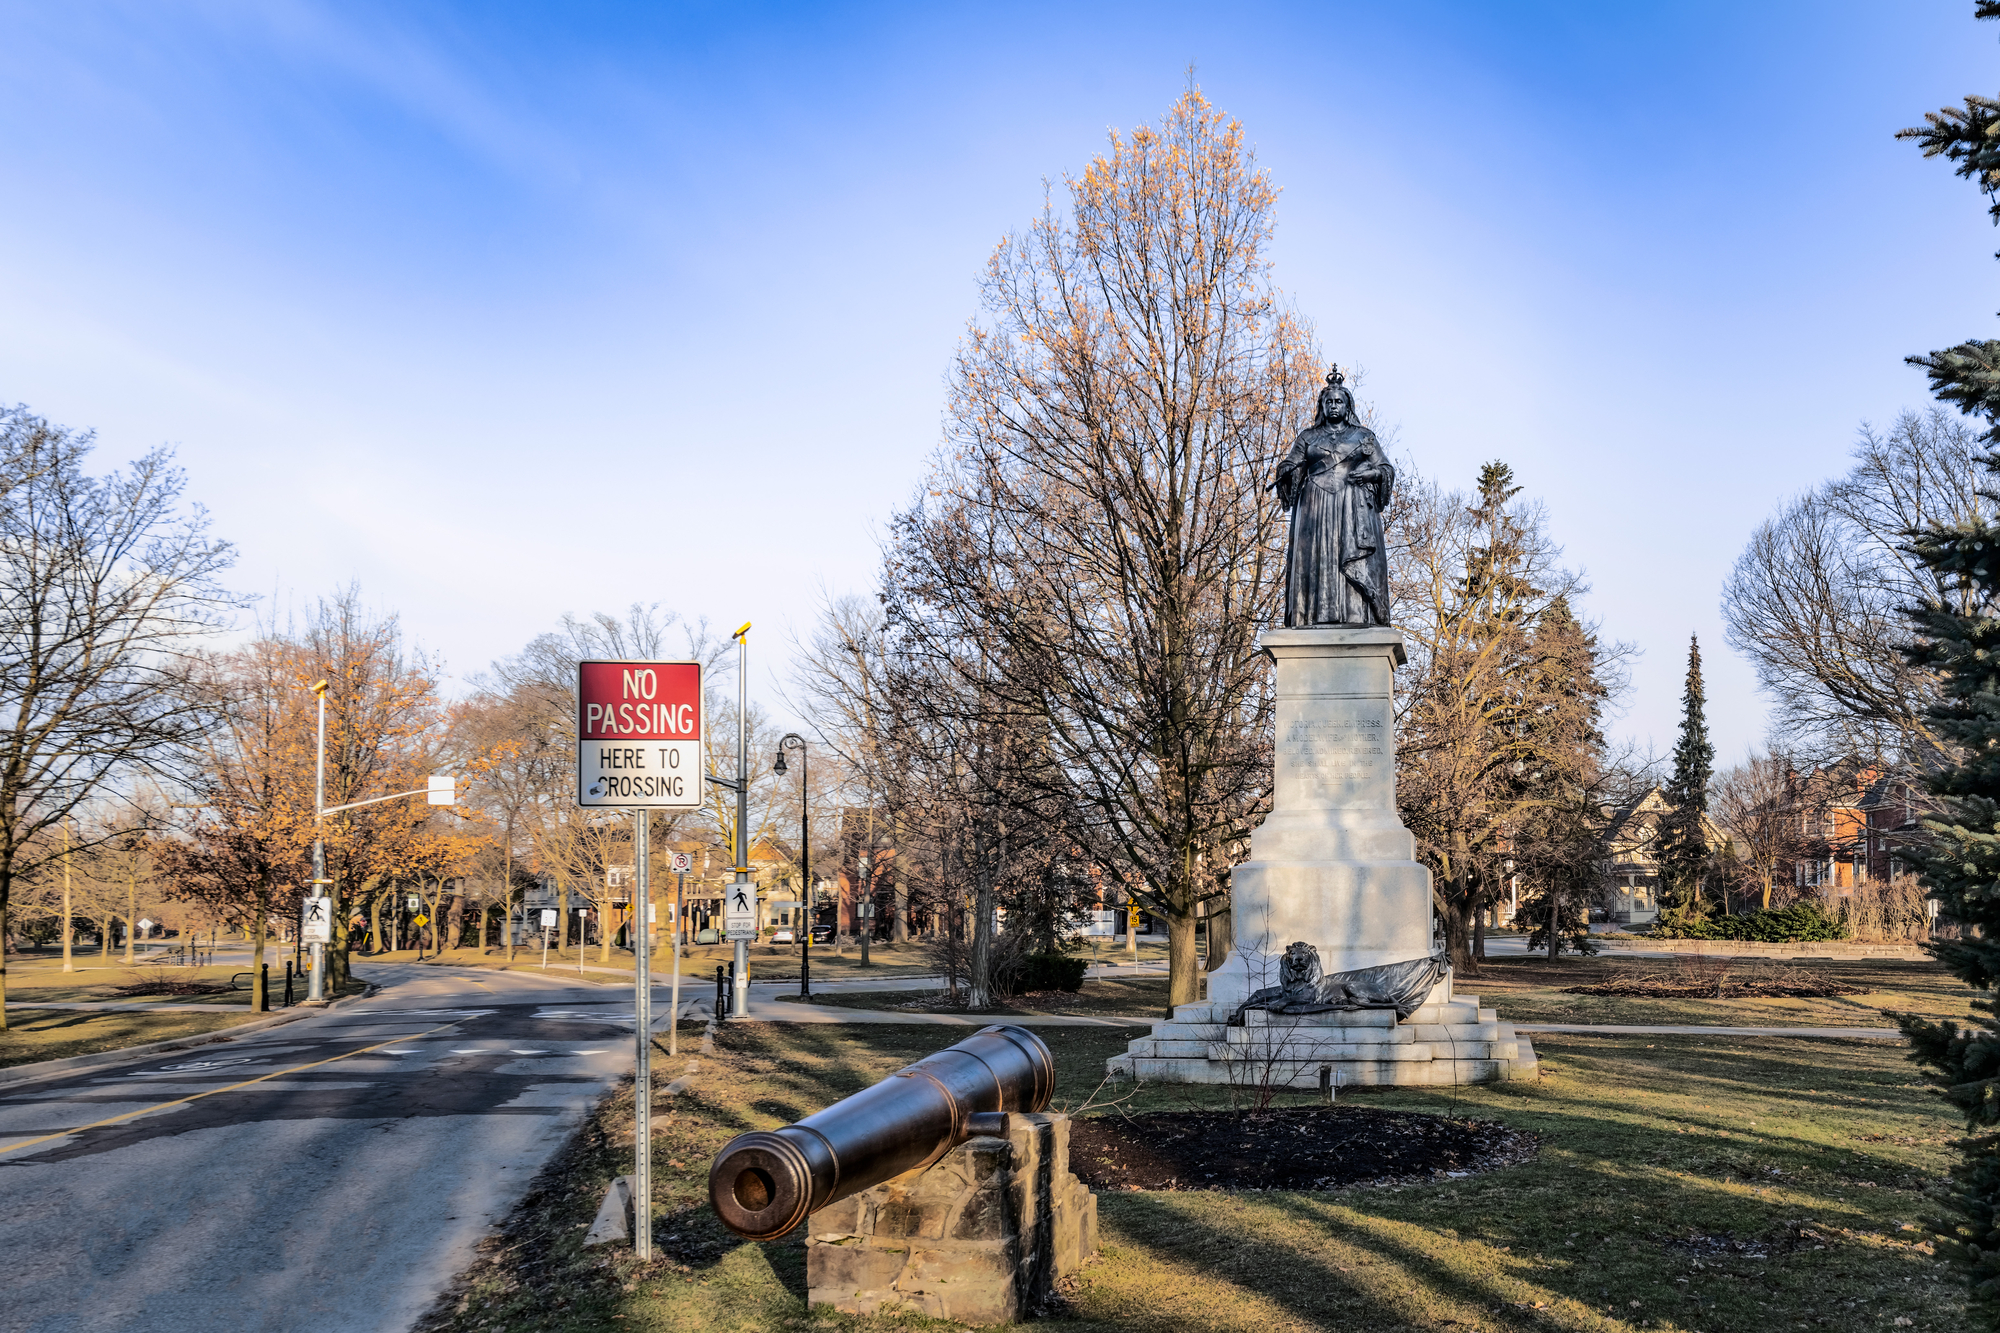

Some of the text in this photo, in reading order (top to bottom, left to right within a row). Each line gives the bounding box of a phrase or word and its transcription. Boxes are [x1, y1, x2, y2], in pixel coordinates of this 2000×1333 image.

[623, 669, 657, 700] NO
[587, 703, 693, 734] PASSING
[1286, 734, 1291, 742] A
[600, 748, 680, 769] HERE TO
